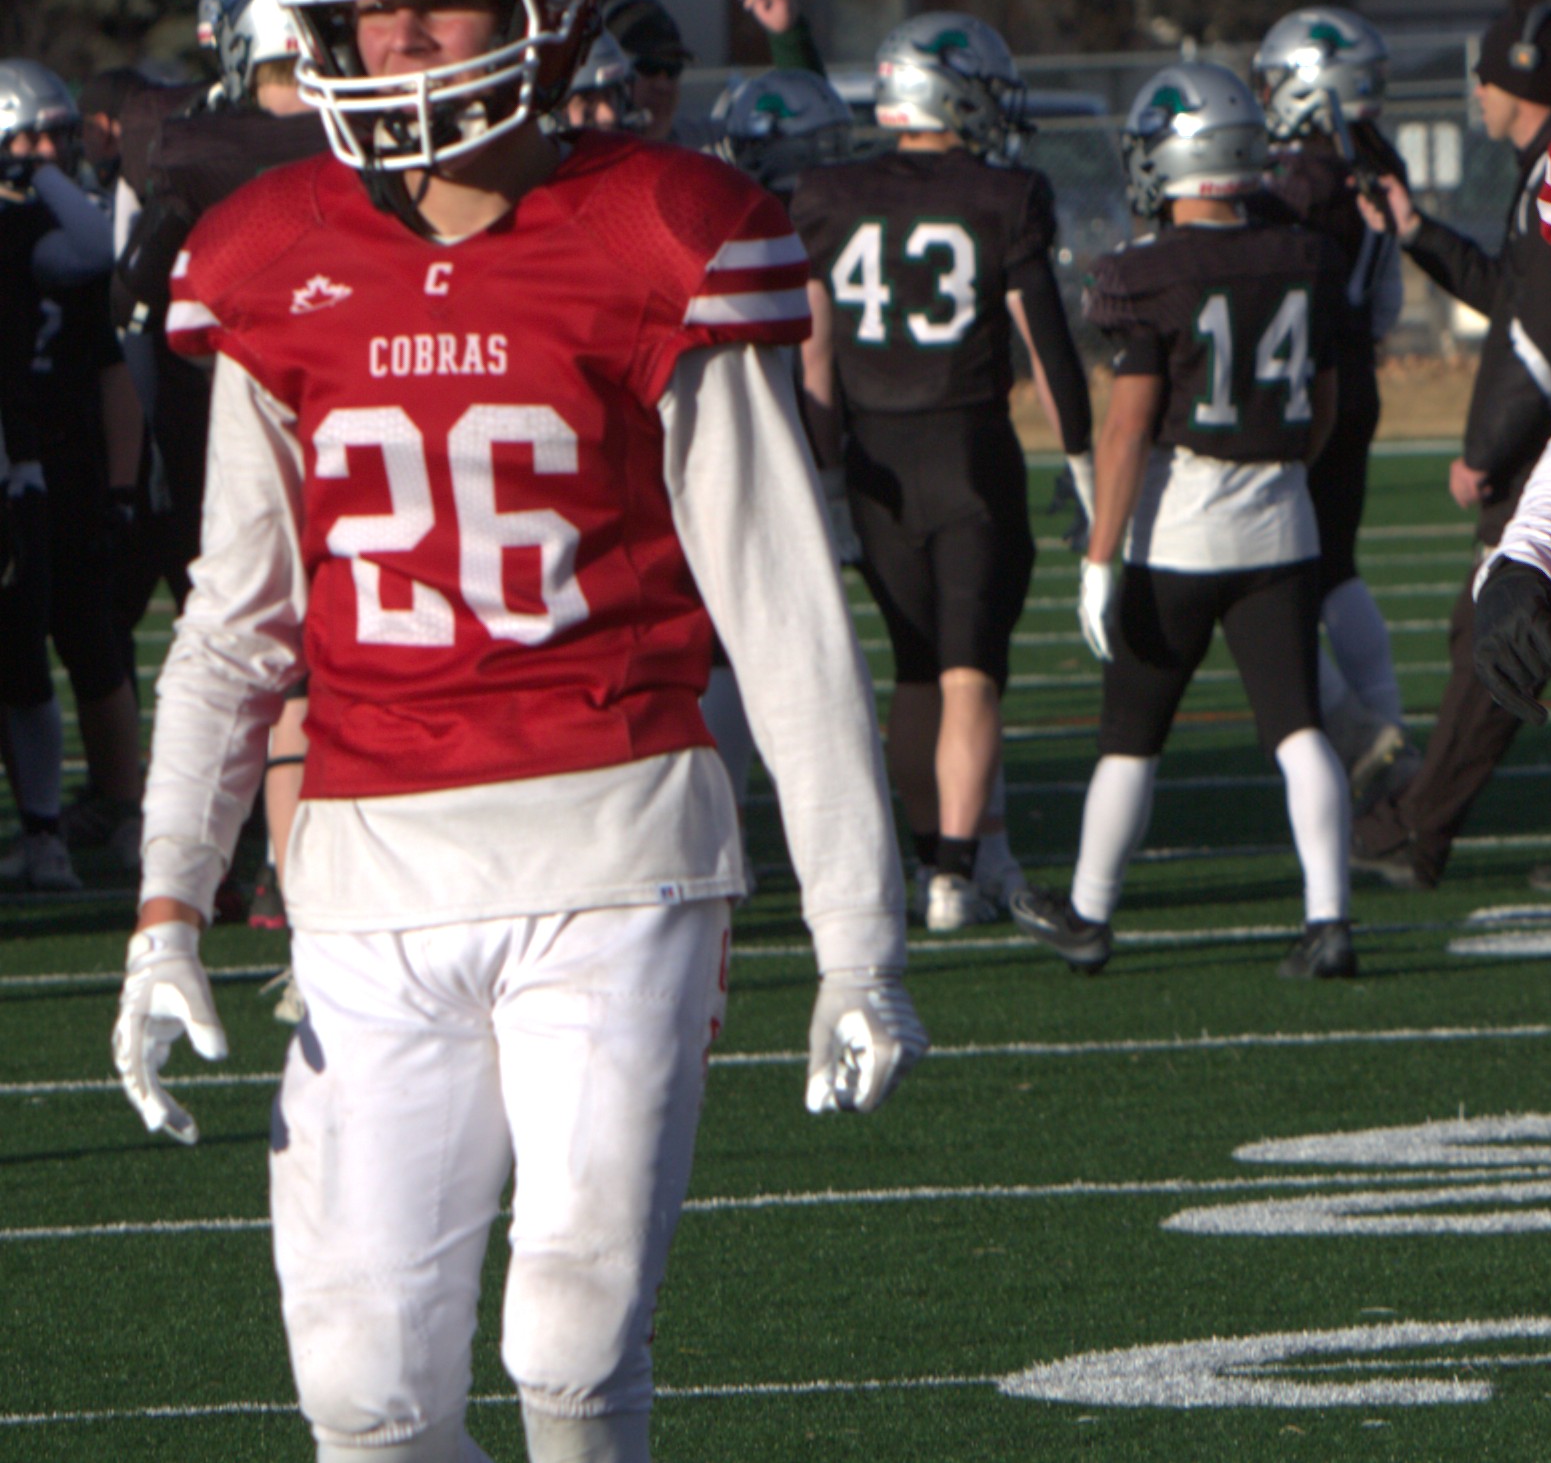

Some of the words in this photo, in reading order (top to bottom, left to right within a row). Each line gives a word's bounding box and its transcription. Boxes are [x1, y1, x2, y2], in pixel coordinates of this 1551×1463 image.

[424, 262, 453, 295] C
[831, 223, 976, 343] 43
[369, 334, 508, 377] COBRAS
[1196, 290, 1313, 425] 14
[312, 404, 590, 647] 26
